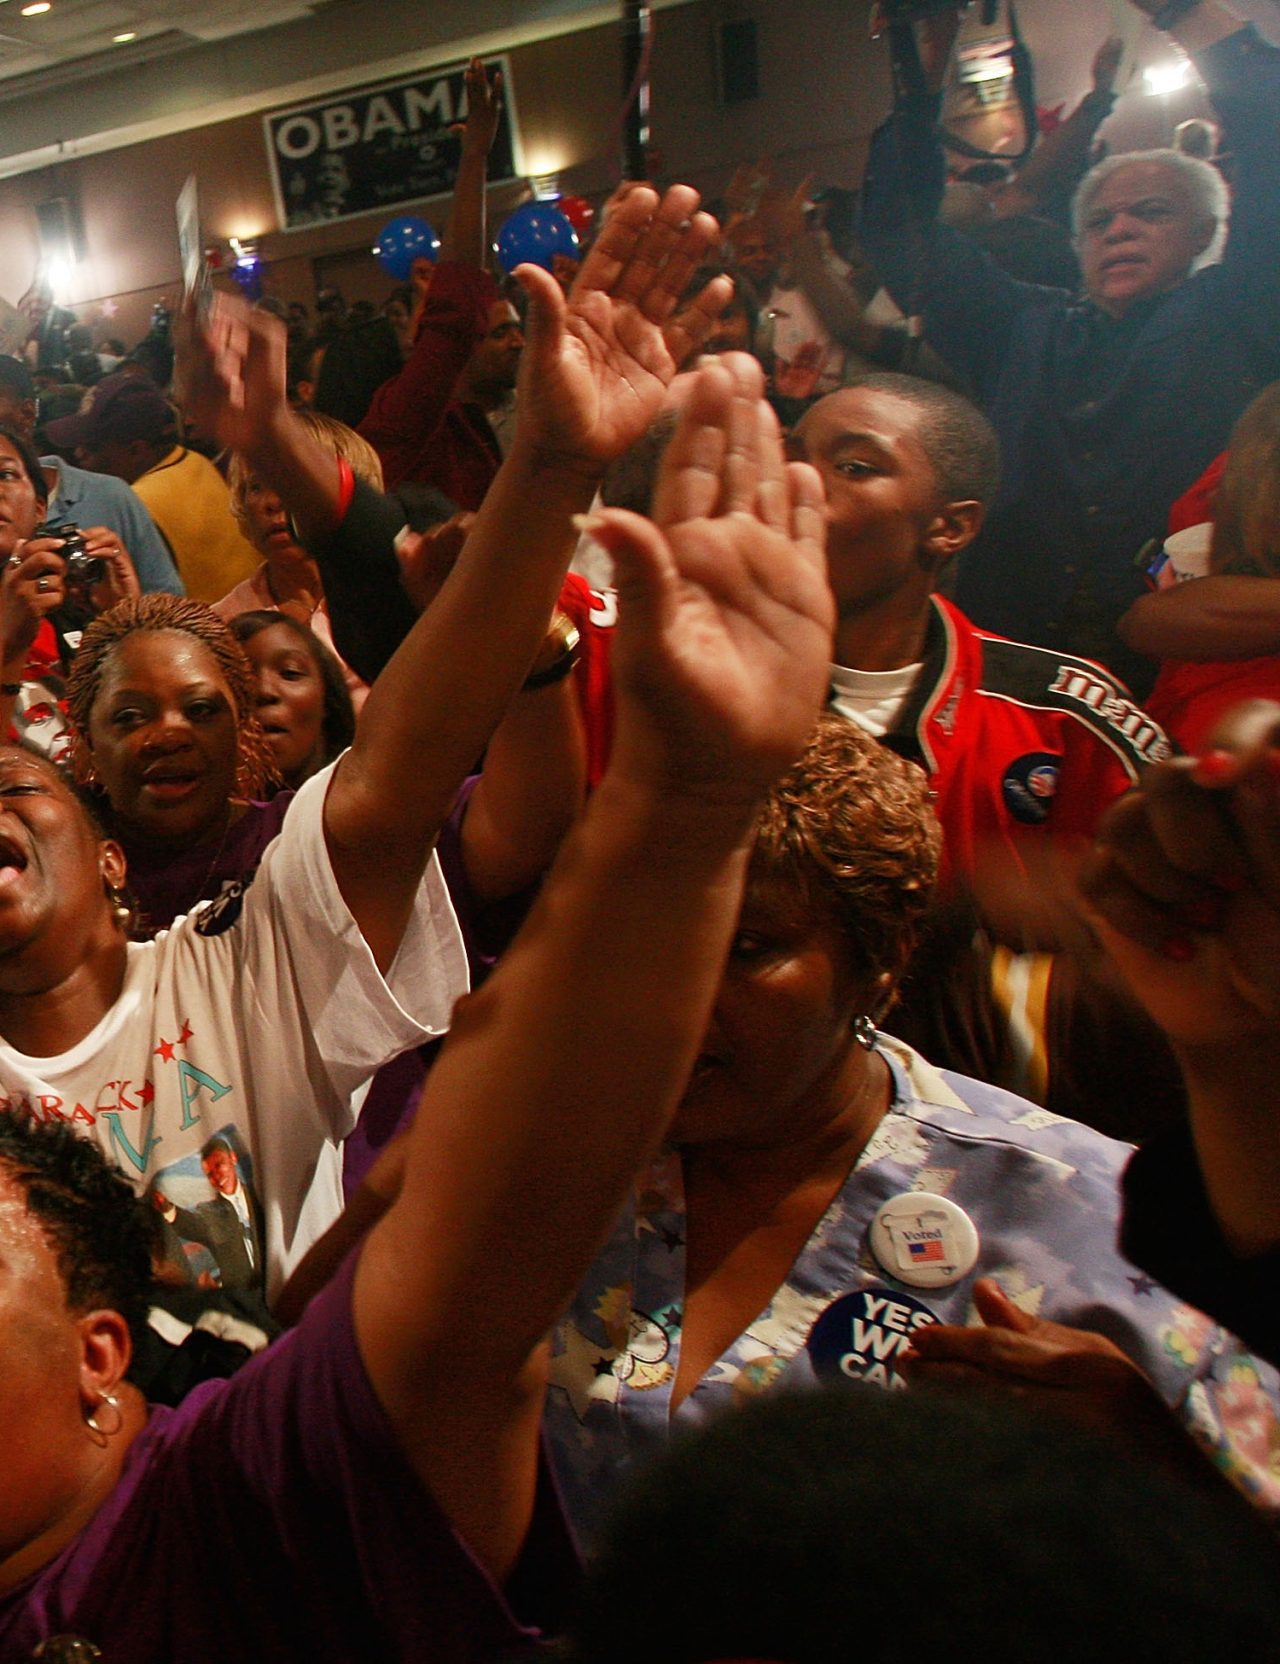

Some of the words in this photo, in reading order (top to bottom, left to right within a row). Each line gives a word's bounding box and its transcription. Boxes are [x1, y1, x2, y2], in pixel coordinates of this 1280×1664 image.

[276, 79, 470, 160] OBAM
[0, 1079, 139, 1126] RACK
[901, 1228, 944, 1241] Voted
[863, 1292, 935, 1333] YES
